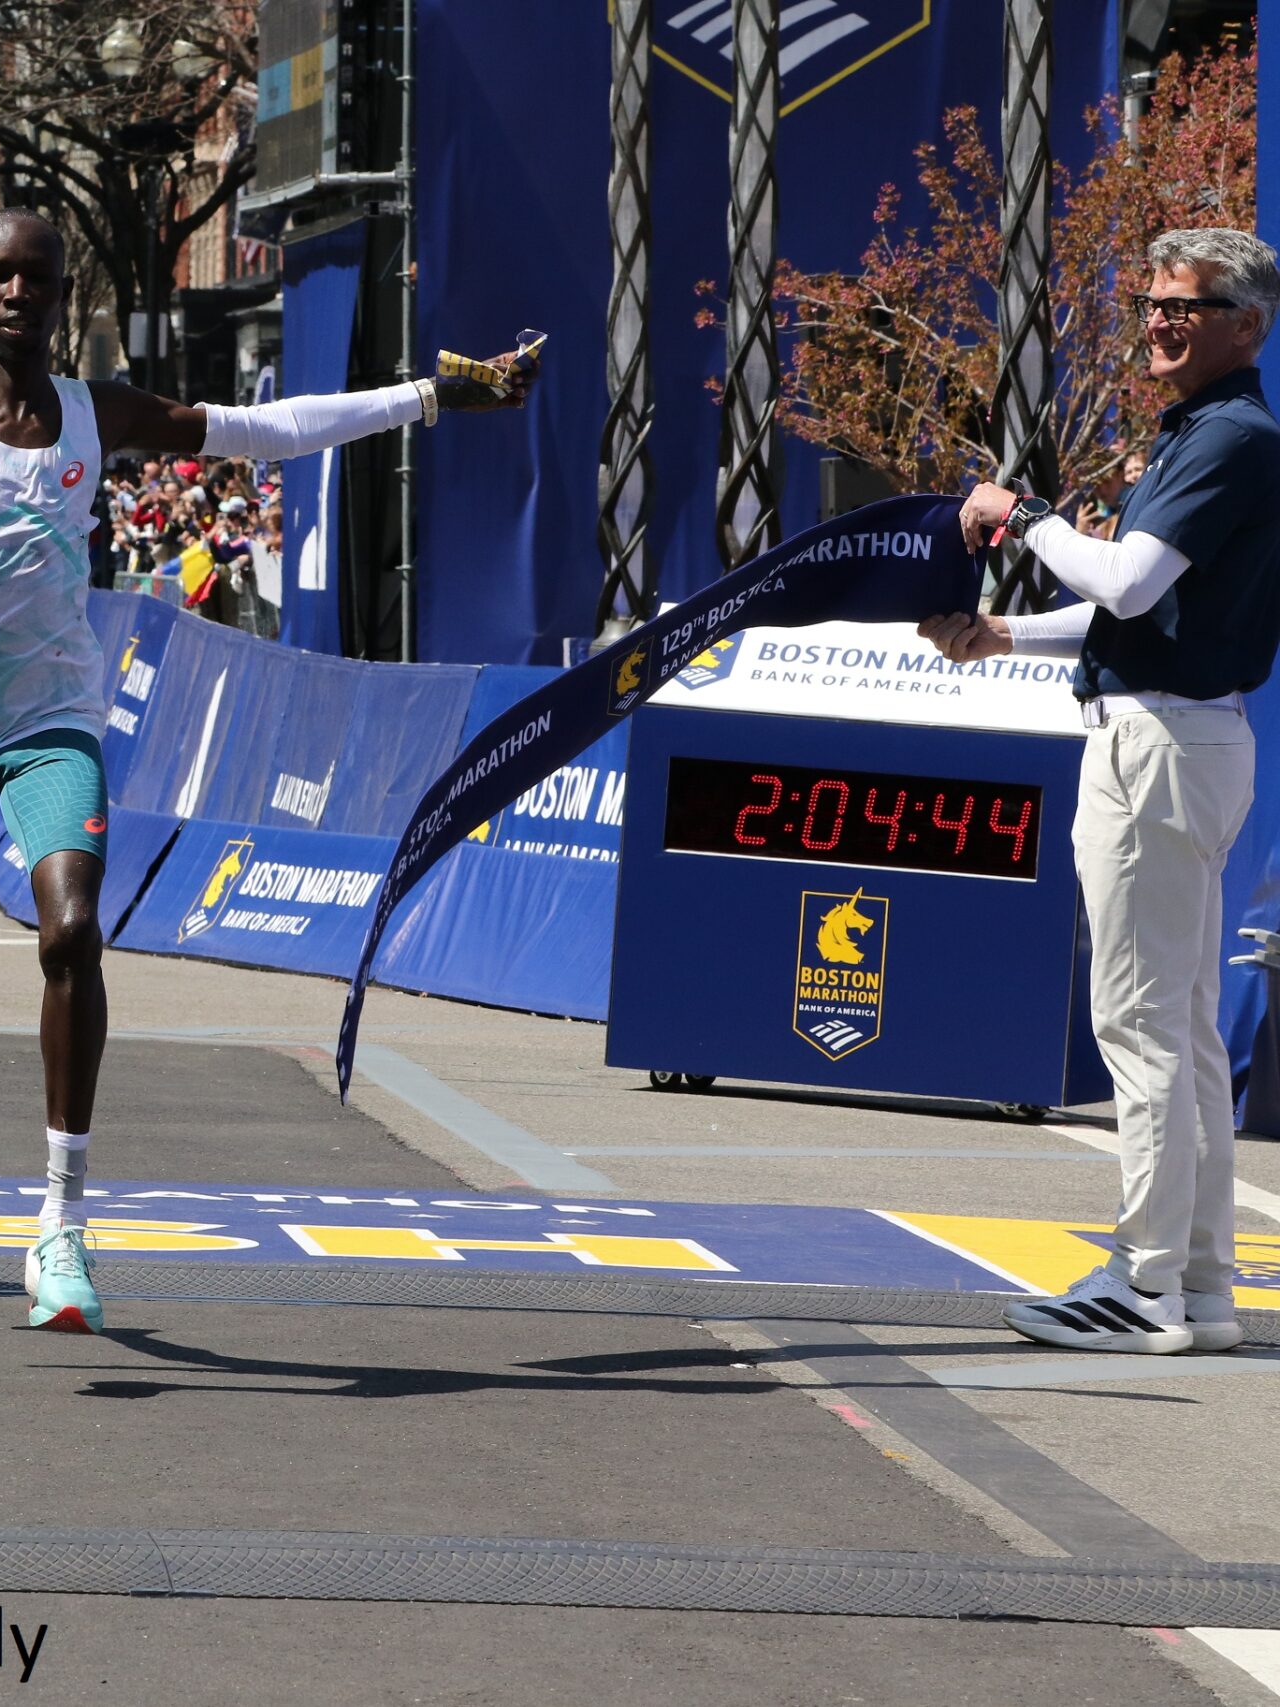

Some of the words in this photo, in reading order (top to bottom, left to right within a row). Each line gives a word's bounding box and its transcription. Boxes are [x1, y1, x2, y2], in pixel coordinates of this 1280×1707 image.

[660, 614, 705, 657] 129TH
[660, 645, 701, 678] BANK
[756, 641, 889, 670] BOSTON
[896, 651, 1077, 685] MARATHON
[750, 669, 814, 685] BANK
[822, 674, 851, 690] OF
[855, 677, 963, 697] AMERICA
[447, 709, 552, 805] MARATHON
[734, 774, 1033, 862] 2:04:44
[238, 861, 306, 902] BOSTON
[294, 866, 384, 908] MARATHON
[220, 908, 257, 930] BANK
[250, 911, 270, 932] OF
[800, 965, 880, 990] BOSTON
[798, 1003, 823, 1013] BANK
[823, 1006, 836, 1014] OF
[836, 1007, 877, 1018] AMERICA
[799, 985, 879, 1005] MARATHON
